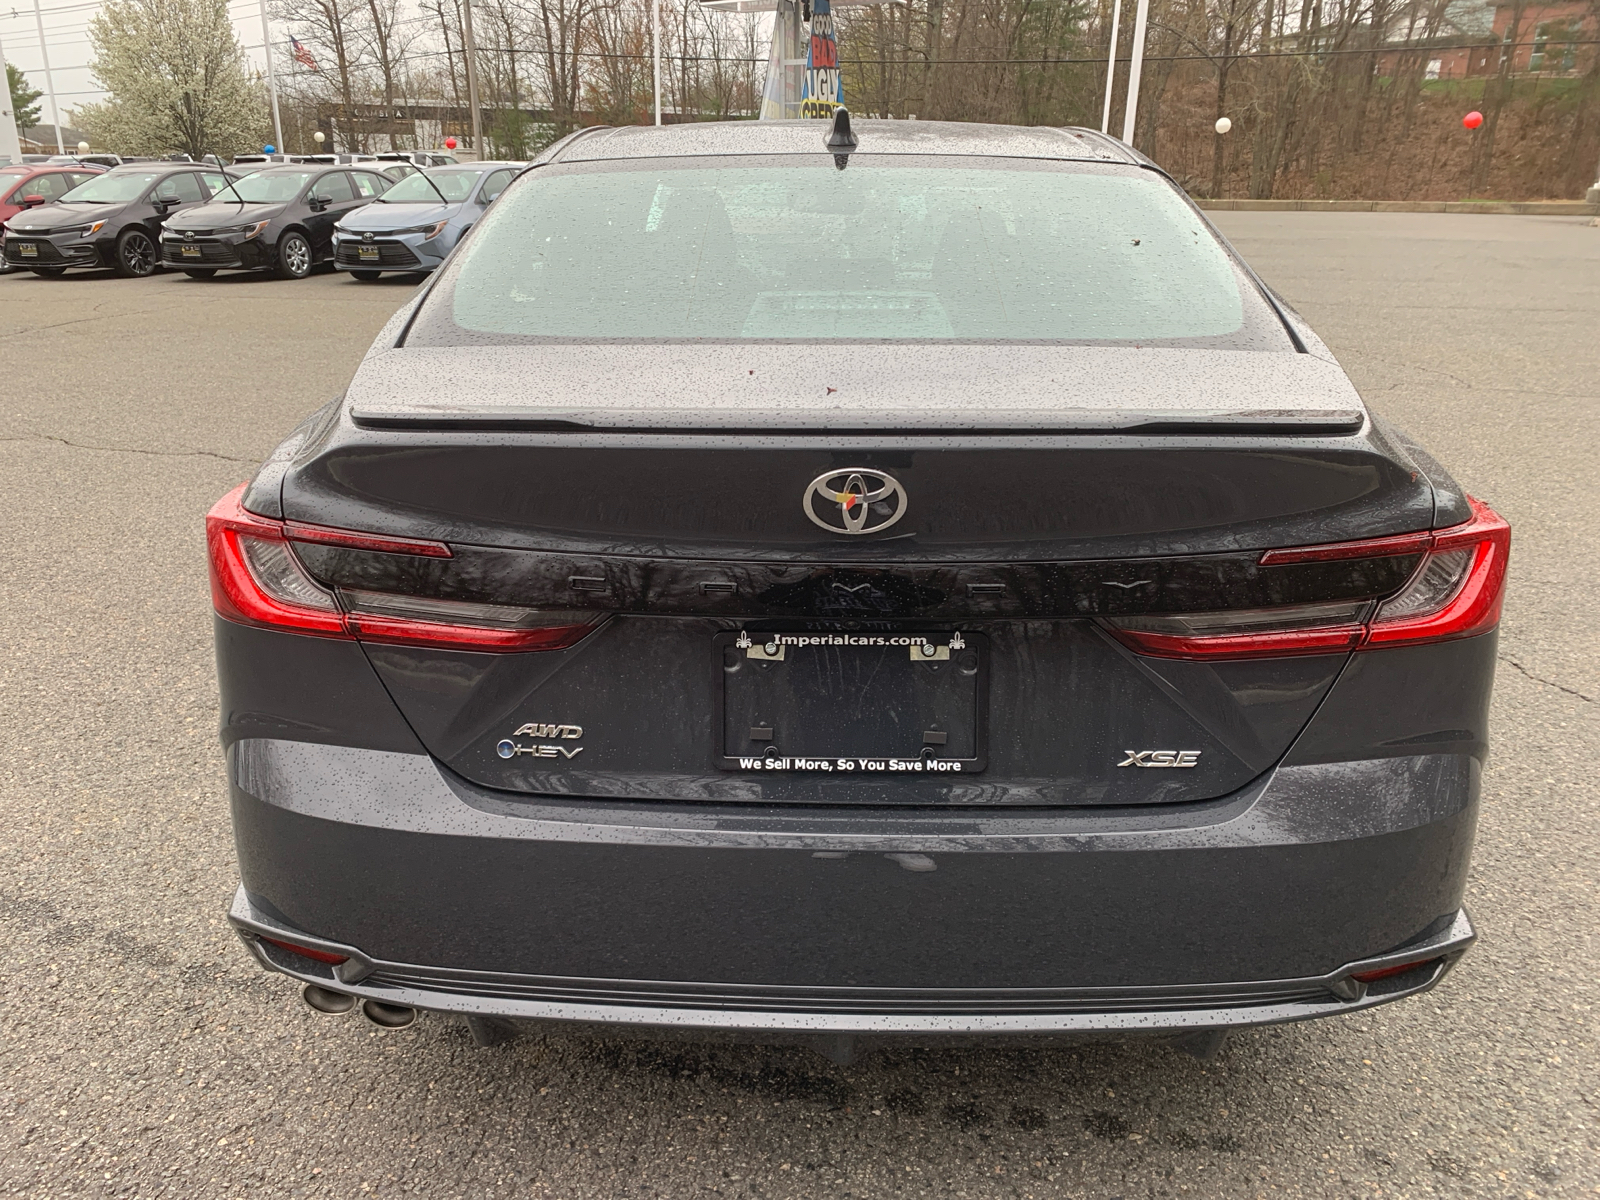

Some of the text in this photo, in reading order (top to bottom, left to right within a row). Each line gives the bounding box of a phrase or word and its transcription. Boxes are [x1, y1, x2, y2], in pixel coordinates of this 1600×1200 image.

[813, 14, 832, 35] GOOD
[811, 35, 837, 68] BAD
[806, 69, 840, 103] UGLY
[773, 633, 927, 648] Imperialcars.com
[512, 722, 584, 739] AWD
[515, 743, 584, 760] HEV
[1116, 750, 1202, 768] XSE
[739, 758, 962, 772] We Sell More, So You Save More
